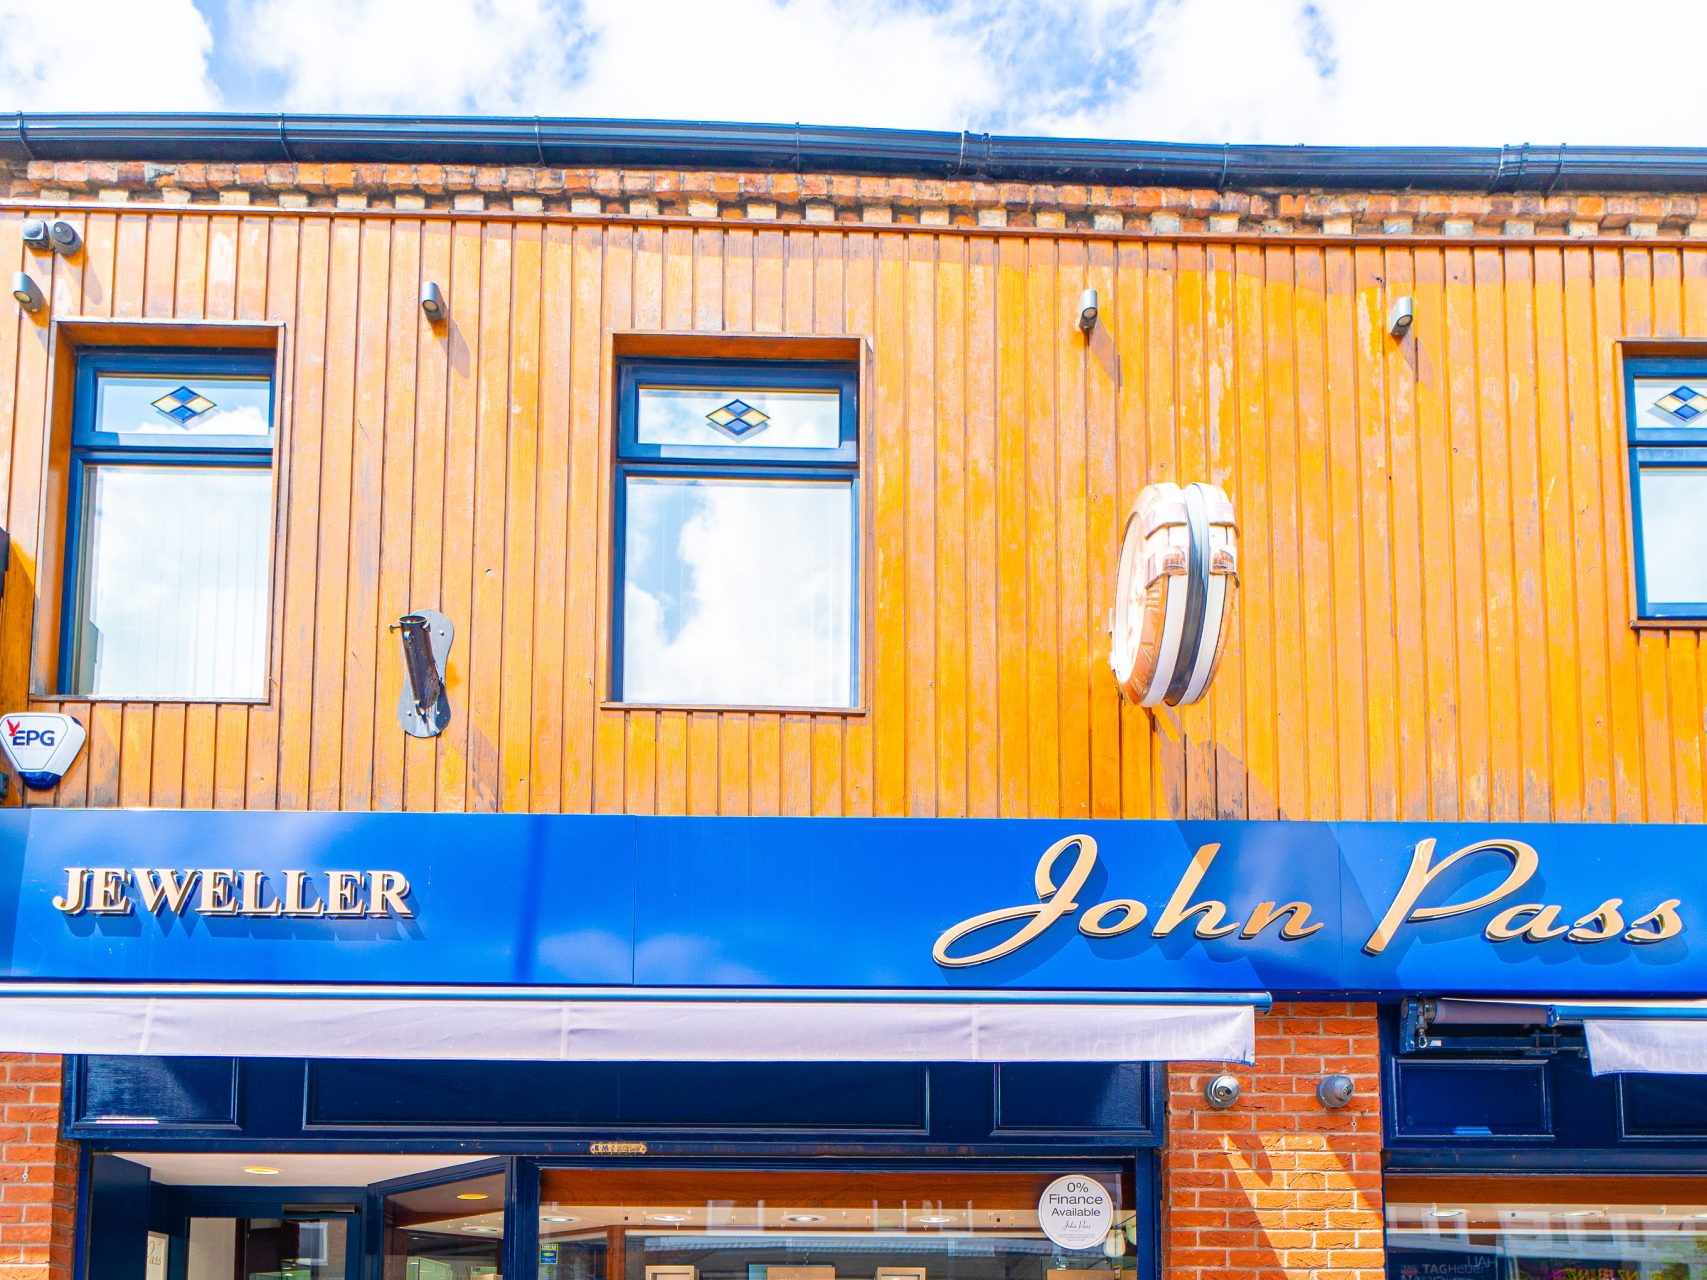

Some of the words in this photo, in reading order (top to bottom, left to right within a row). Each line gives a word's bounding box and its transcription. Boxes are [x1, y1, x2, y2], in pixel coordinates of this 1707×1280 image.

[13, 730, 55, 746] EPG
[52, 868, 414, 919] JEWELLER
[932, 834, 1323, 968] John
[1363, 837, 1684, 955] Pass
[1067, 1182, 1089, 1193] 0%
[1049, 1194, 1103, 1205] Finance
[1051, 1207, 1101, 1217] Available
